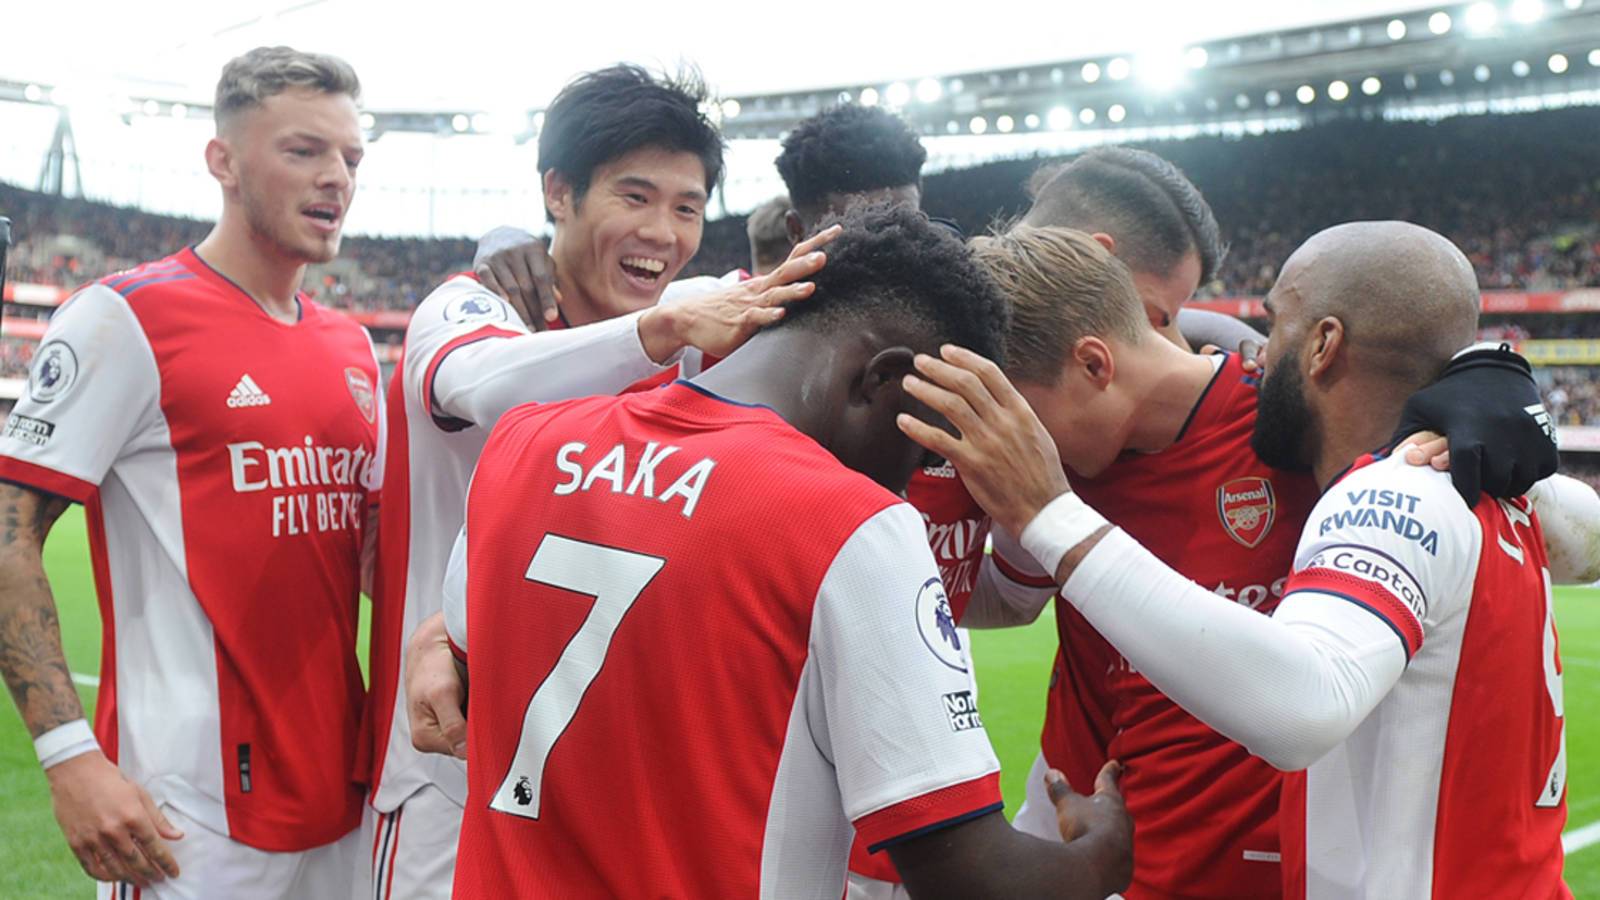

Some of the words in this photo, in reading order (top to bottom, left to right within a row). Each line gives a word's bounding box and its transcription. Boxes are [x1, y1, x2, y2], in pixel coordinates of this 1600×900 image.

[226, 393, 272, 408] adidas
[553, 441, 717, 518] SAKA
[1224, 488, 1265, 504] Arsenal
[273, 495, 309, 537] FLY
[1347, 488, 1421, 514] VISIT
[1319, 508, 1439, 556] RWANDA
[488, 532, 667, 820] 7
